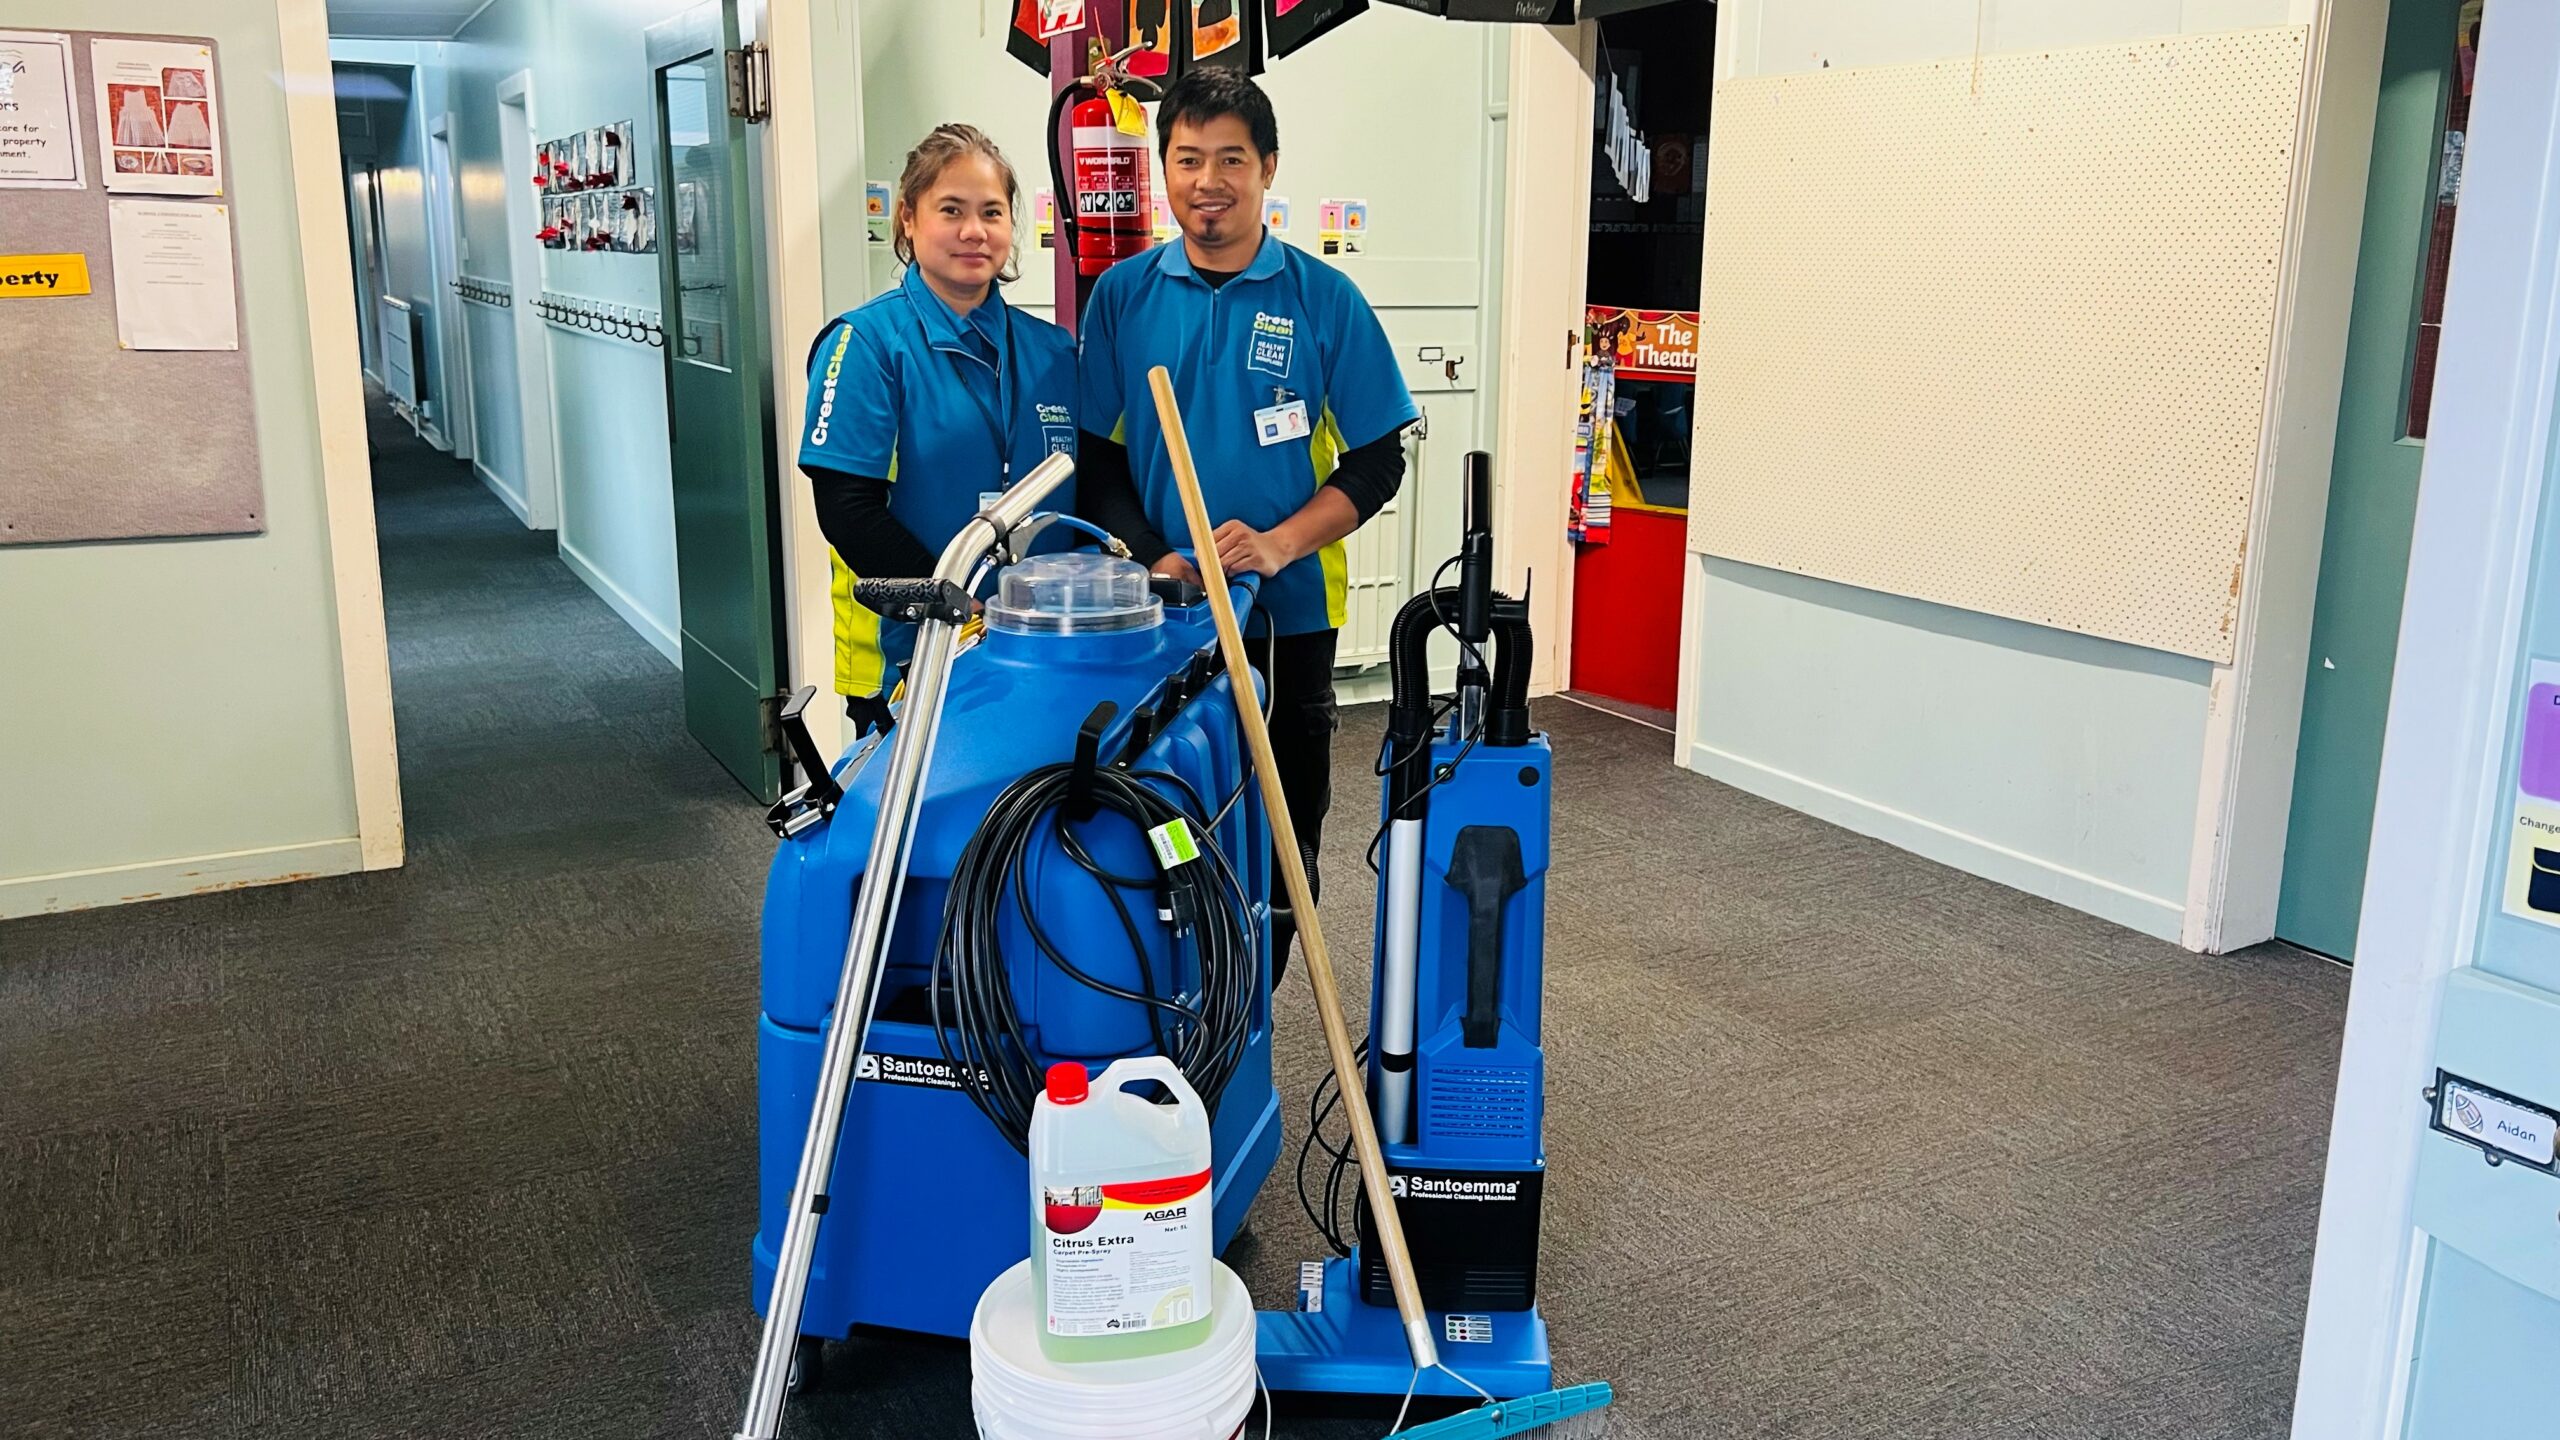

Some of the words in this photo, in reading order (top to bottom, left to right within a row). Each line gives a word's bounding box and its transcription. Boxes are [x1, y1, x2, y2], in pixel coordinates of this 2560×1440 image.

[24, 124, 39, 132] for
[3, 138, 46, 148] property
[0, 271, 59, 288] erty
[1255, 311, 1294, 328] Crest
[1254, 321, 1293, 336] Clean
[1656, 324, 1692, 345] The
[1256, 347, 1285, 361] CLEAN
[1257, 341, 1286, 353] HEALTHY
[1636, 345, 1697, 368] Theatr
[1036, 403, 1069, 415] Crest
[1040, 412, 1072, 423] Clean
[2519, 816, 2560, 834] Change
[882, 1056, 989, 1082] Santoea
[883, 1072, 925, 1083] Professional
[926, 1077, 956, 1088] Cleaning
[2497, 1120, 2537, 1143] Aidan
[1411, 1176, 1516, 1194] Santoemma
[1411, 1191, 1452, 1199] Professional
[1453, 1194, 1483, 1202] Cleaning
[1143, 1207, 1187, 1221] AGAR
[1053, 1238, 1093, 1248] Citrus
[1098, 1236, 1134, 1246] Extra
